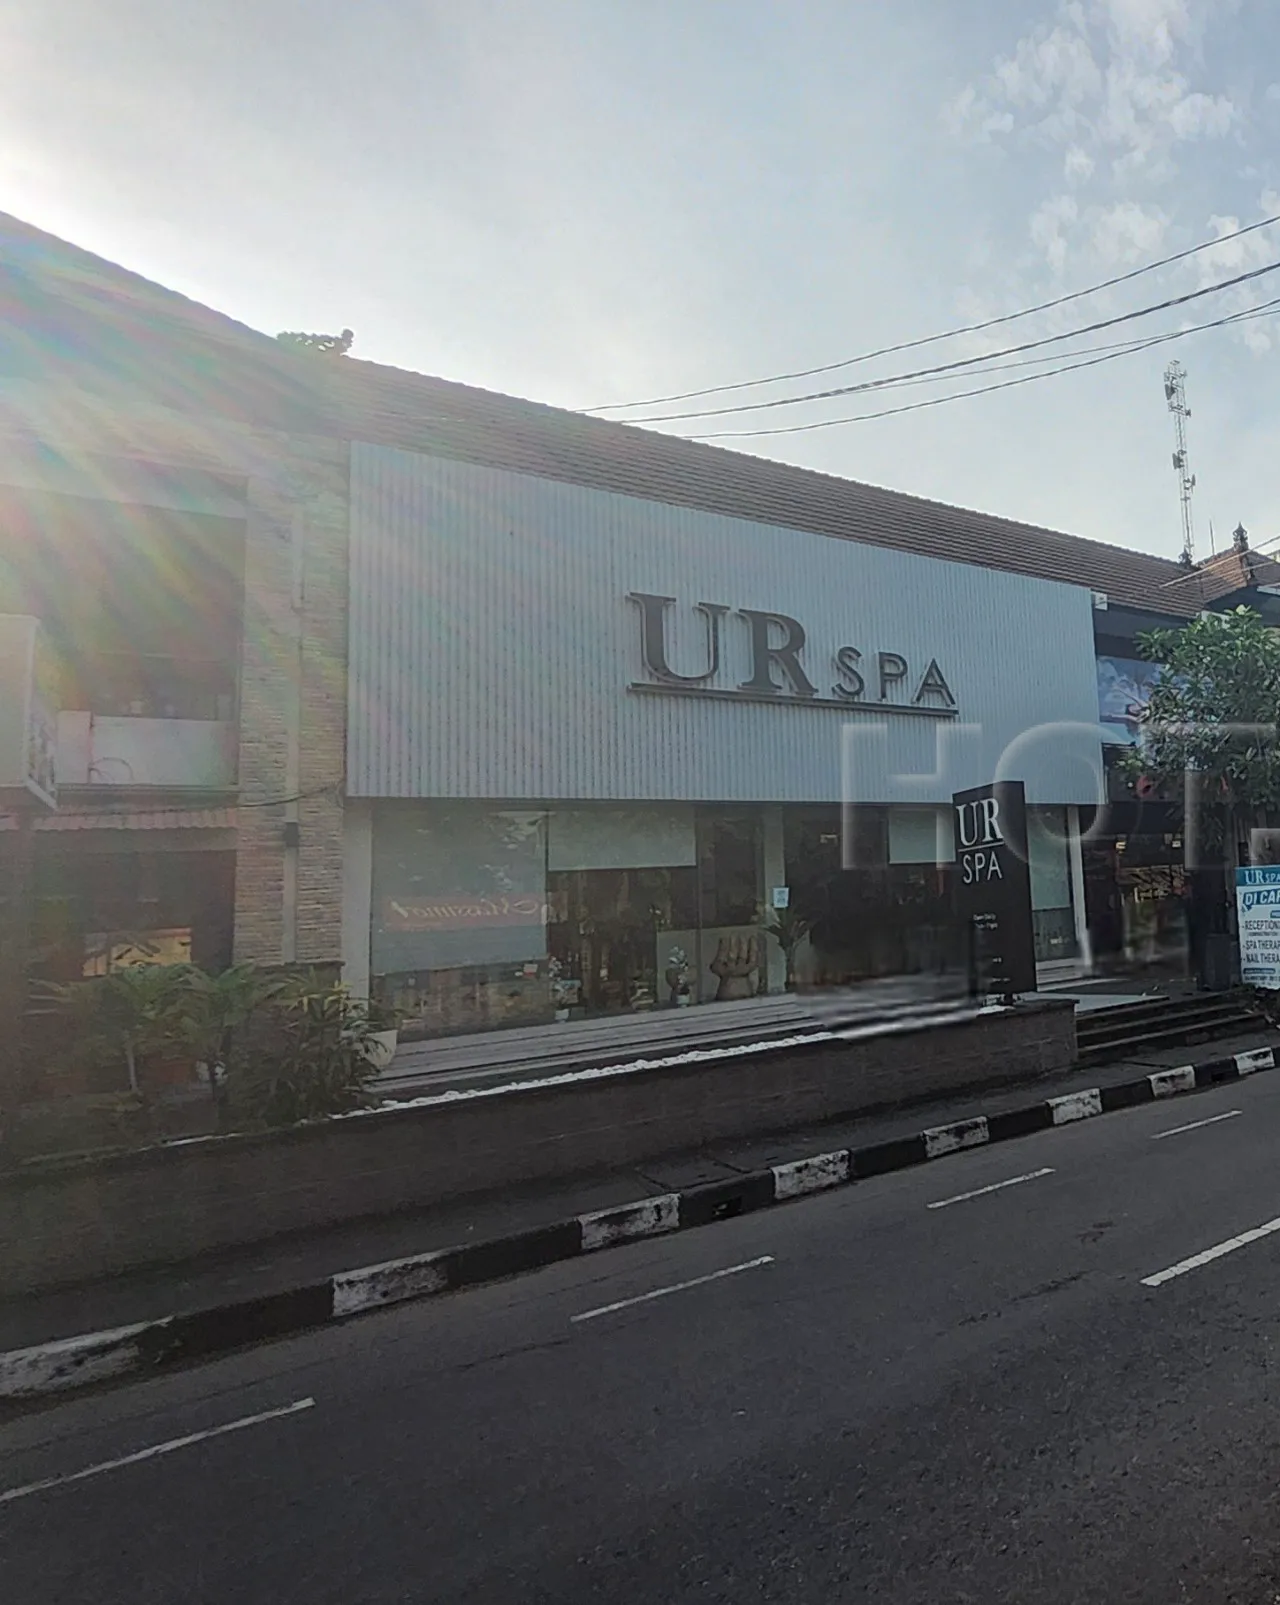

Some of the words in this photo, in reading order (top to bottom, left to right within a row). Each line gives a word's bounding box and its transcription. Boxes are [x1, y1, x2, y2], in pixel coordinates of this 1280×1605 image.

[626, 592, 818, 697] UR
[832, 645, 956, 706] SPA
[956, 797, 1005, 846] UR
[963, 851, 1003, 884] SPA
[1244, 869, 1265, 885] UR
[1245, 893, 1258, 905] DI
